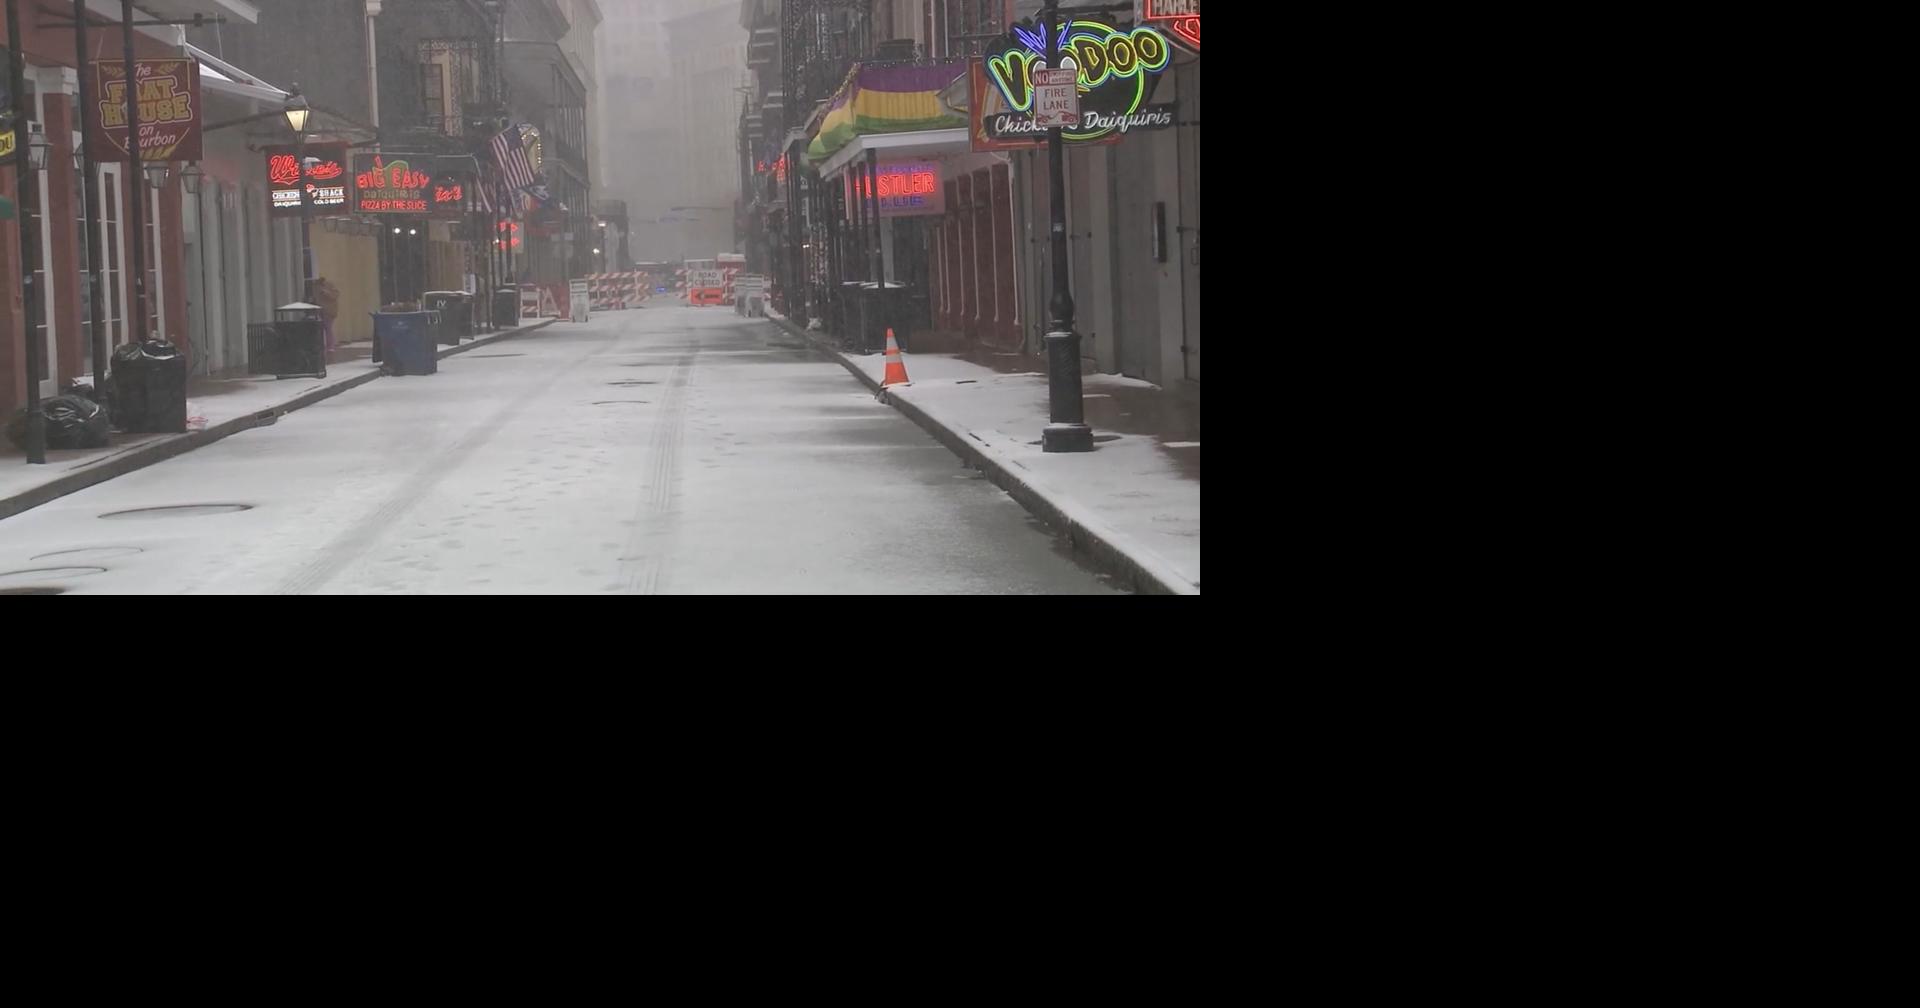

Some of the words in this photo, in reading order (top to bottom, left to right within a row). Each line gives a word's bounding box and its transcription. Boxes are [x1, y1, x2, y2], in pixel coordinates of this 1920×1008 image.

[1035, 71, 1049, 85] NO
[1044, 88, 1068, 98] FIRE
[1043, 100, 1069, 110] LANE
[1084, 108, 1171, 133] Daiquiris
[139, 126, 154, 137] on
[357, 168, 386, 188] BIG
[391, 167, 430, 189] EASY
[318, 188, 344, 197] SHACK
[361, 200, 381, 210] PIZZA
[381, 200, 391, 210] BY
[392, 200, 407, 210] THE
[407, 200, 428, 210] SLICE
